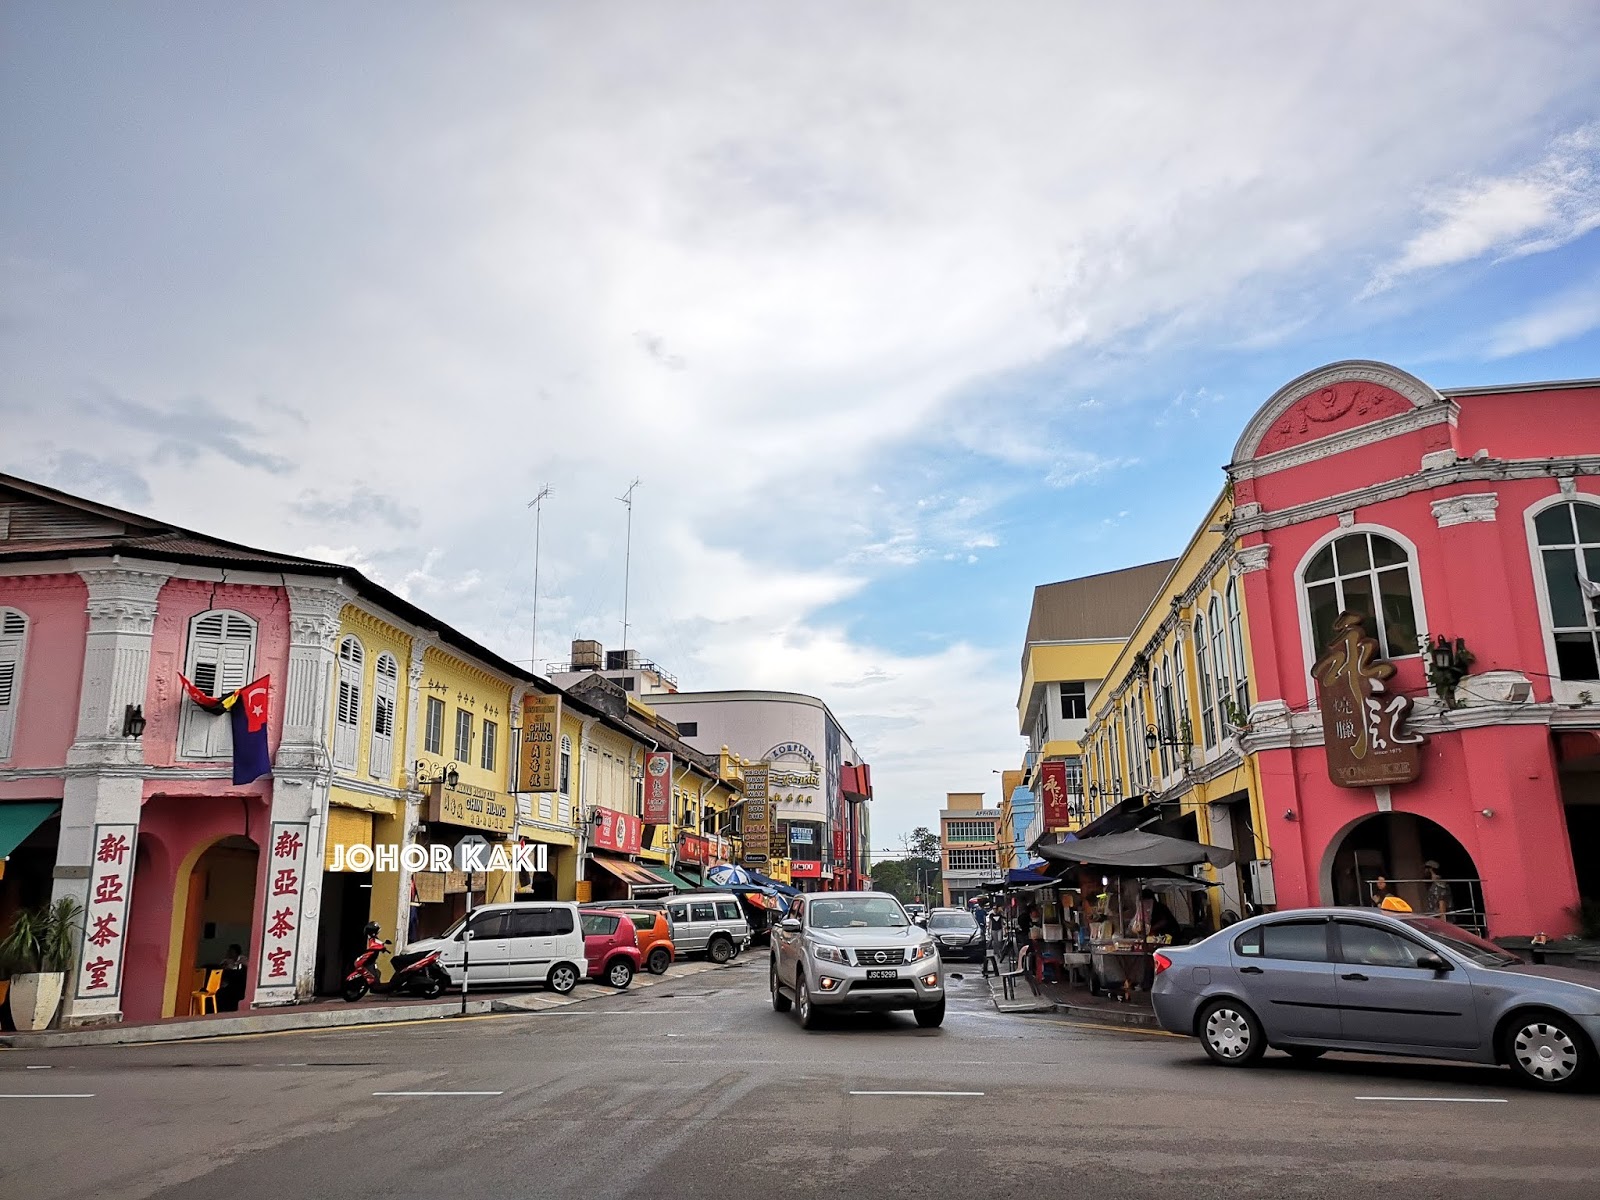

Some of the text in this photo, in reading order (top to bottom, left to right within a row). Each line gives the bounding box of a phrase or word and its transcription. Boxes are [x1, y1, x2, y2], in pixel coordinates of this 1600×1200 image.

[1313, 612, 1424, 759] 永記
[528, 722, 551, 732] CHIN
[525, 732, 553, 742] HIANG
[466, 797, 483, 812] CHIN
[486, 801, 506, 817] HIANG
[86, 833, 130, 990] 新亞茶室
[267, 830, 303, 977] 新亞茶室
